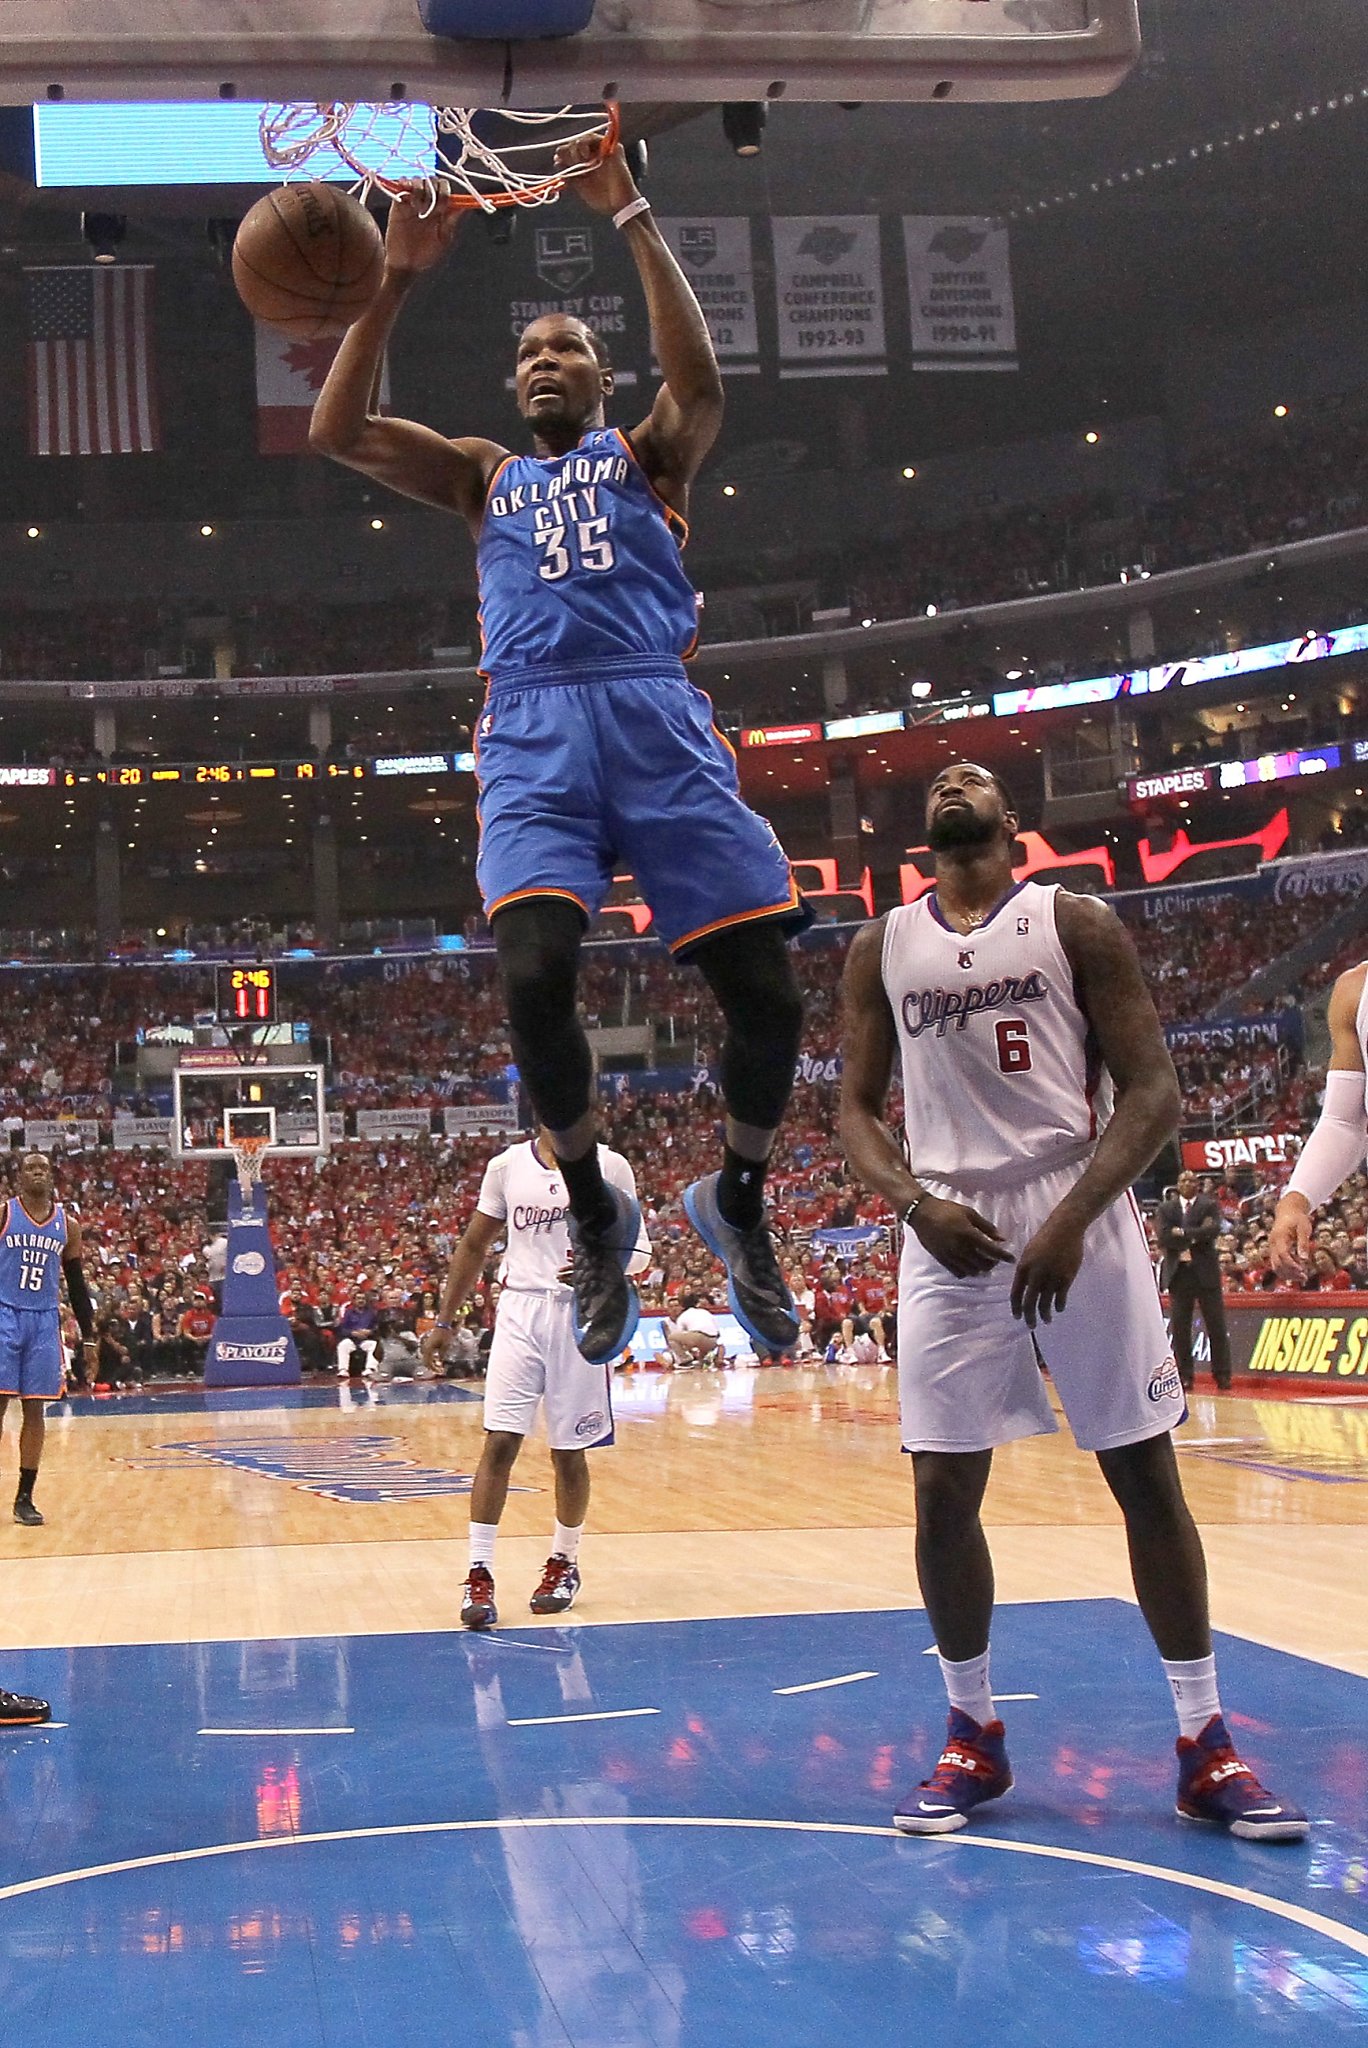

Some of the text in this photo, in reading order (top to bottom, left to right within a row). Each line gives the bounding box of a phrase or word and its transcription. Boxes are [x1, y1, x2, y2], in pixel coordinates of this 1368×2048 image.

[541, 234, 587, 255] LA
[589, 296, 625, 313] CUP
[784, 290, 876, 306] CONFERENCE
[930, 287, 992, 301] DIVISION
[788, 307, 872, 324] CHAMPIONS
[920, 304, 1002, 319] CHAMPIONS
[797, 328, 865, 347] 1992-93
[932, 325, 996, 343] 1990-91
[491, 456, 629, 517] OKLAHOMA
[534, 487, 599, 531] CITY
[531, 514, 616, 581] 35
[119, 768, 141, 785] 20
[195, 766, 230, 783] 2:46
[297, 763, 313, 779] 19
[1135, 771, 1205, 799] STAPLES
[231, 969, 271, 989] 2:46
[236, 988, 269, 1018] 11
[902, 968, 1049, 1038] Clippers
[994, 1018, 1033, 1075] 6
[22, 1249, 49, 1266] CITY
[20, 1265, 44, 1291] 15
[225, 1345, 286, 1360] PLAYOFFS
[1249, 1317, 1345, 1374] INSIDE
